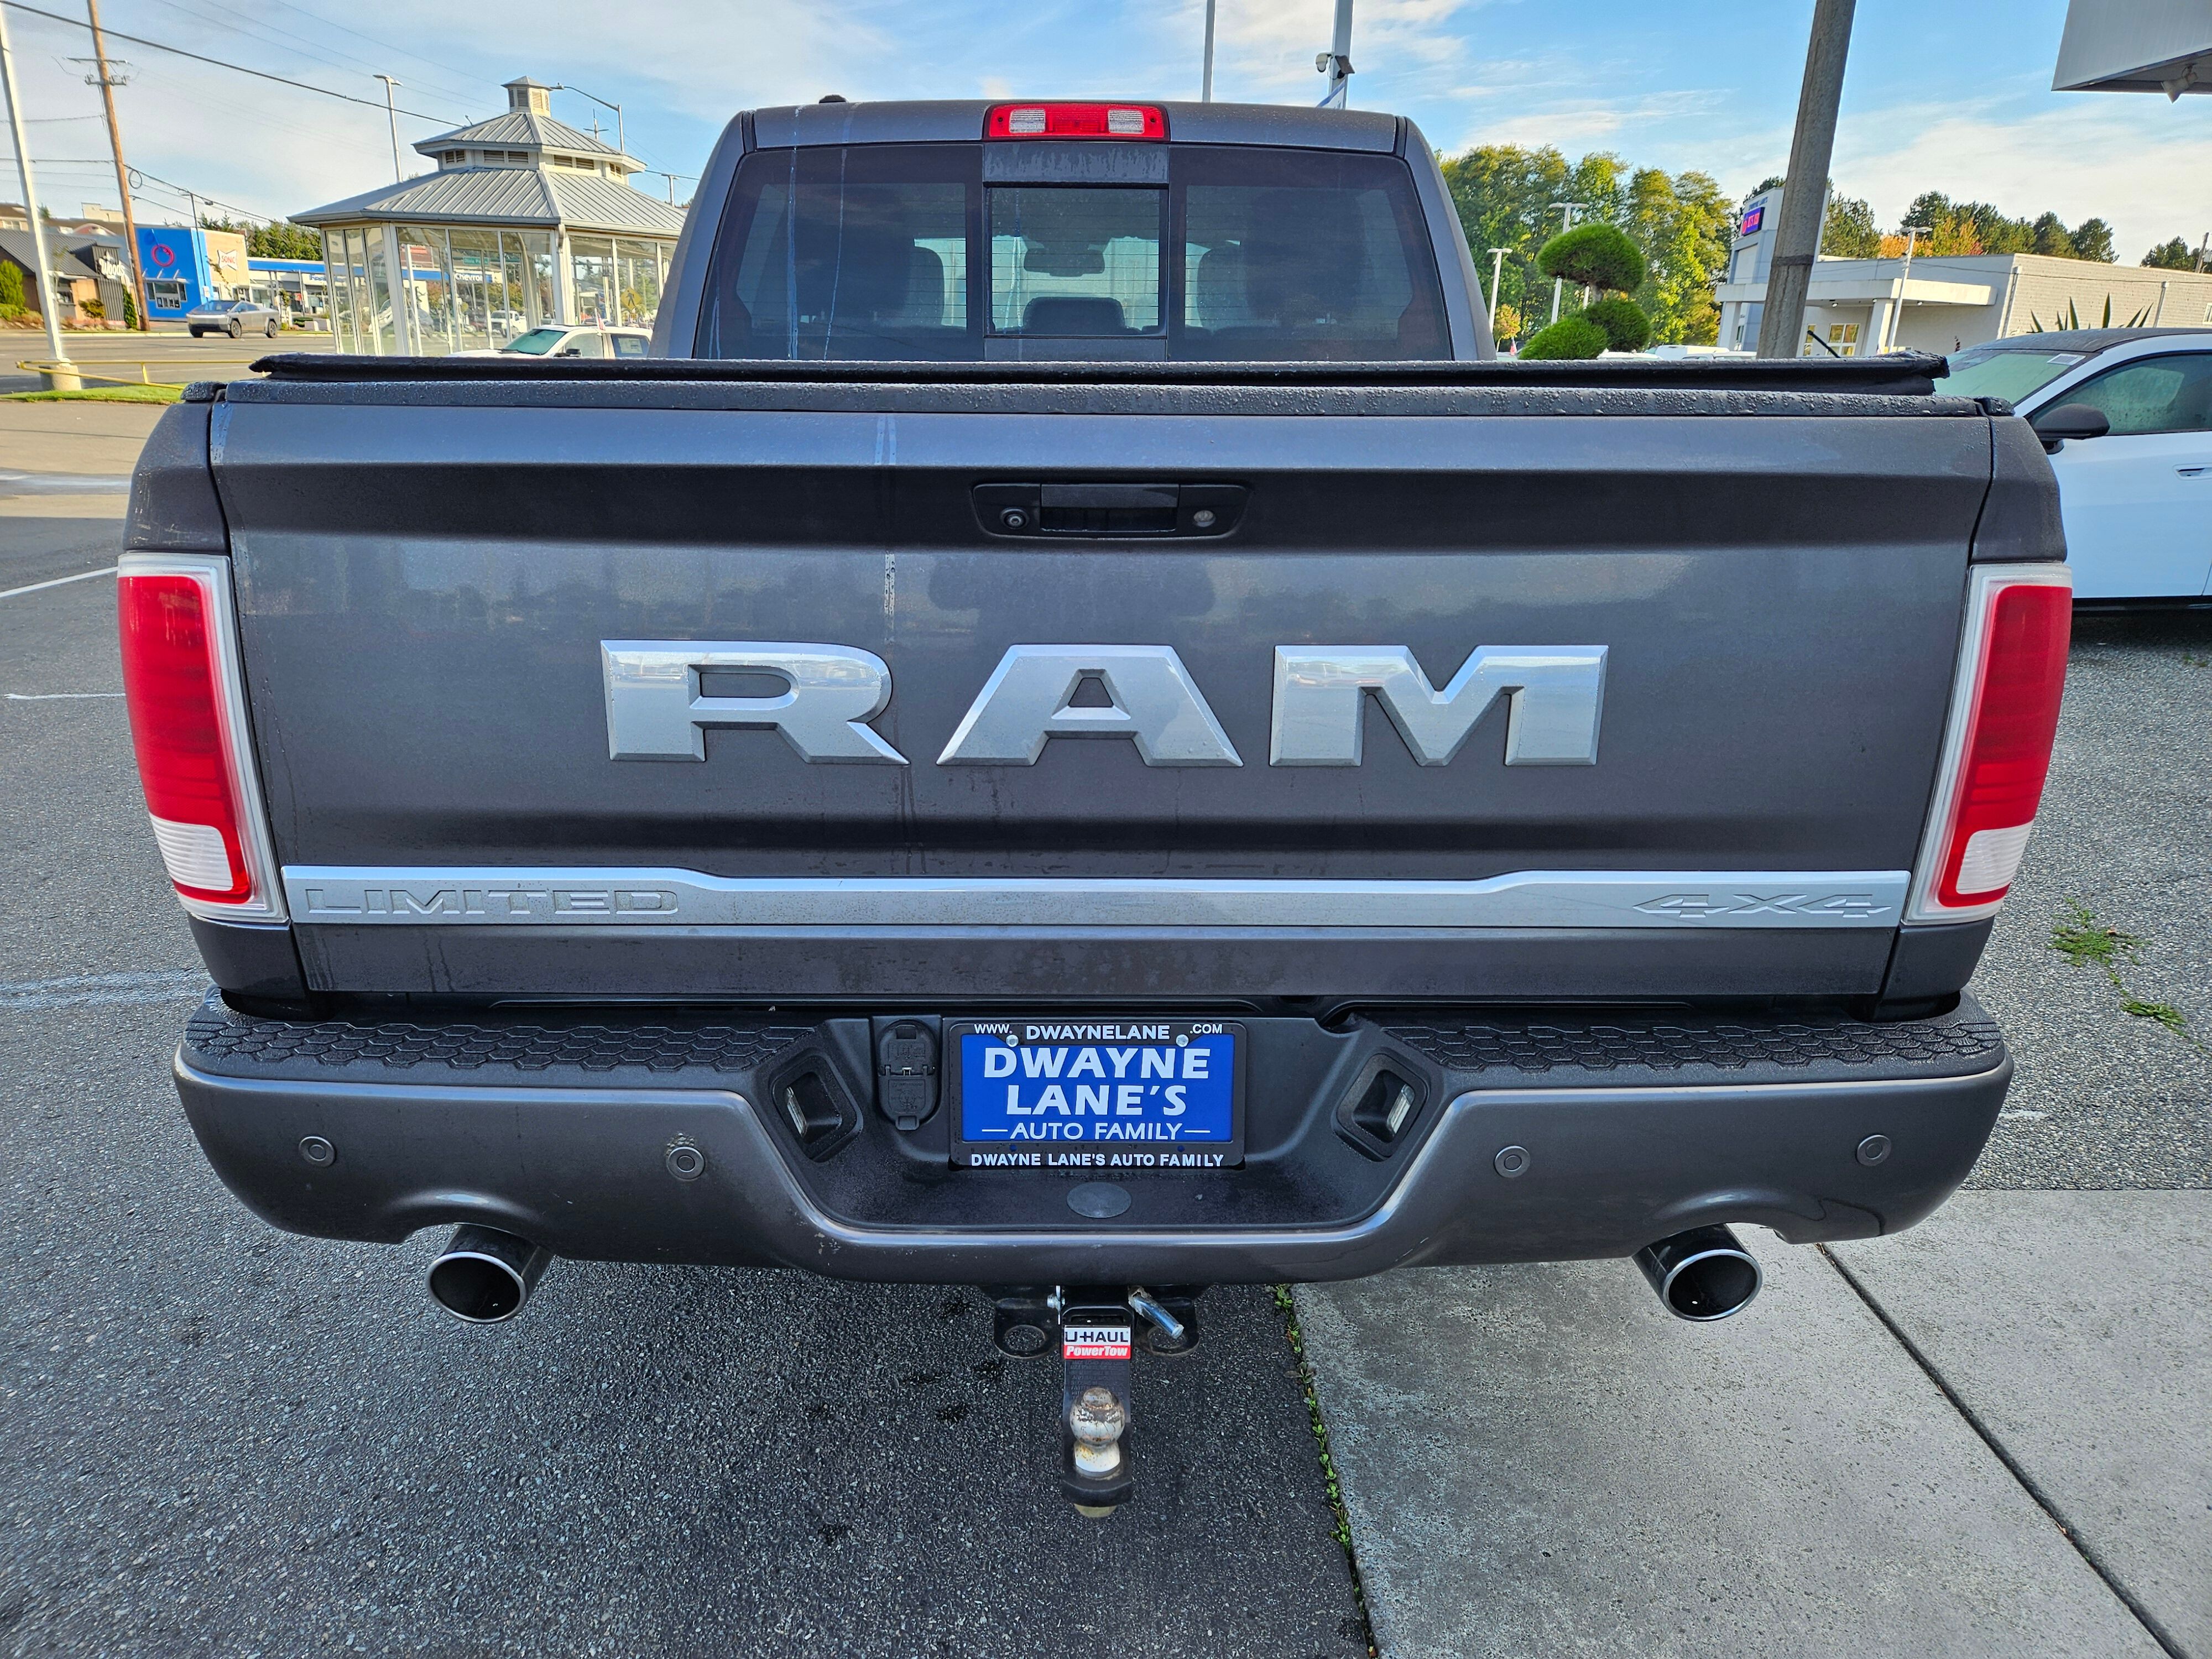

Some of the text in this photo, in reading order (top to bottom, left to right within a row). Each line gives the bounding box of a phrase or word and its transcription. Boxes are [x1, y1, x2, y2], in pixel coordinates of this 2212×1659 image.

[221, 255, 235, 264] SONIC
[600, 640, 1609, 766] RAM
[305, 889, 679, 915] LIMITED
[1026, 1025, 1170, 1040] DWAYNELANE
[1190, 1024, 1223, 1034] .COM
[984, 1046, 1211, 1079] DWAYNE
[1006, 1085, 1187, 1115] LANE'S
[1010, 1122, 1183, 1140] AUTO FAMILY
[971, 1152, 1224, 1167] DWAYNE LANE'S AUTO FAMILY
[1065, 1331, 1129, 1343] U-HAUL
[1066, 1345, 1128, 1357] PowerTow
